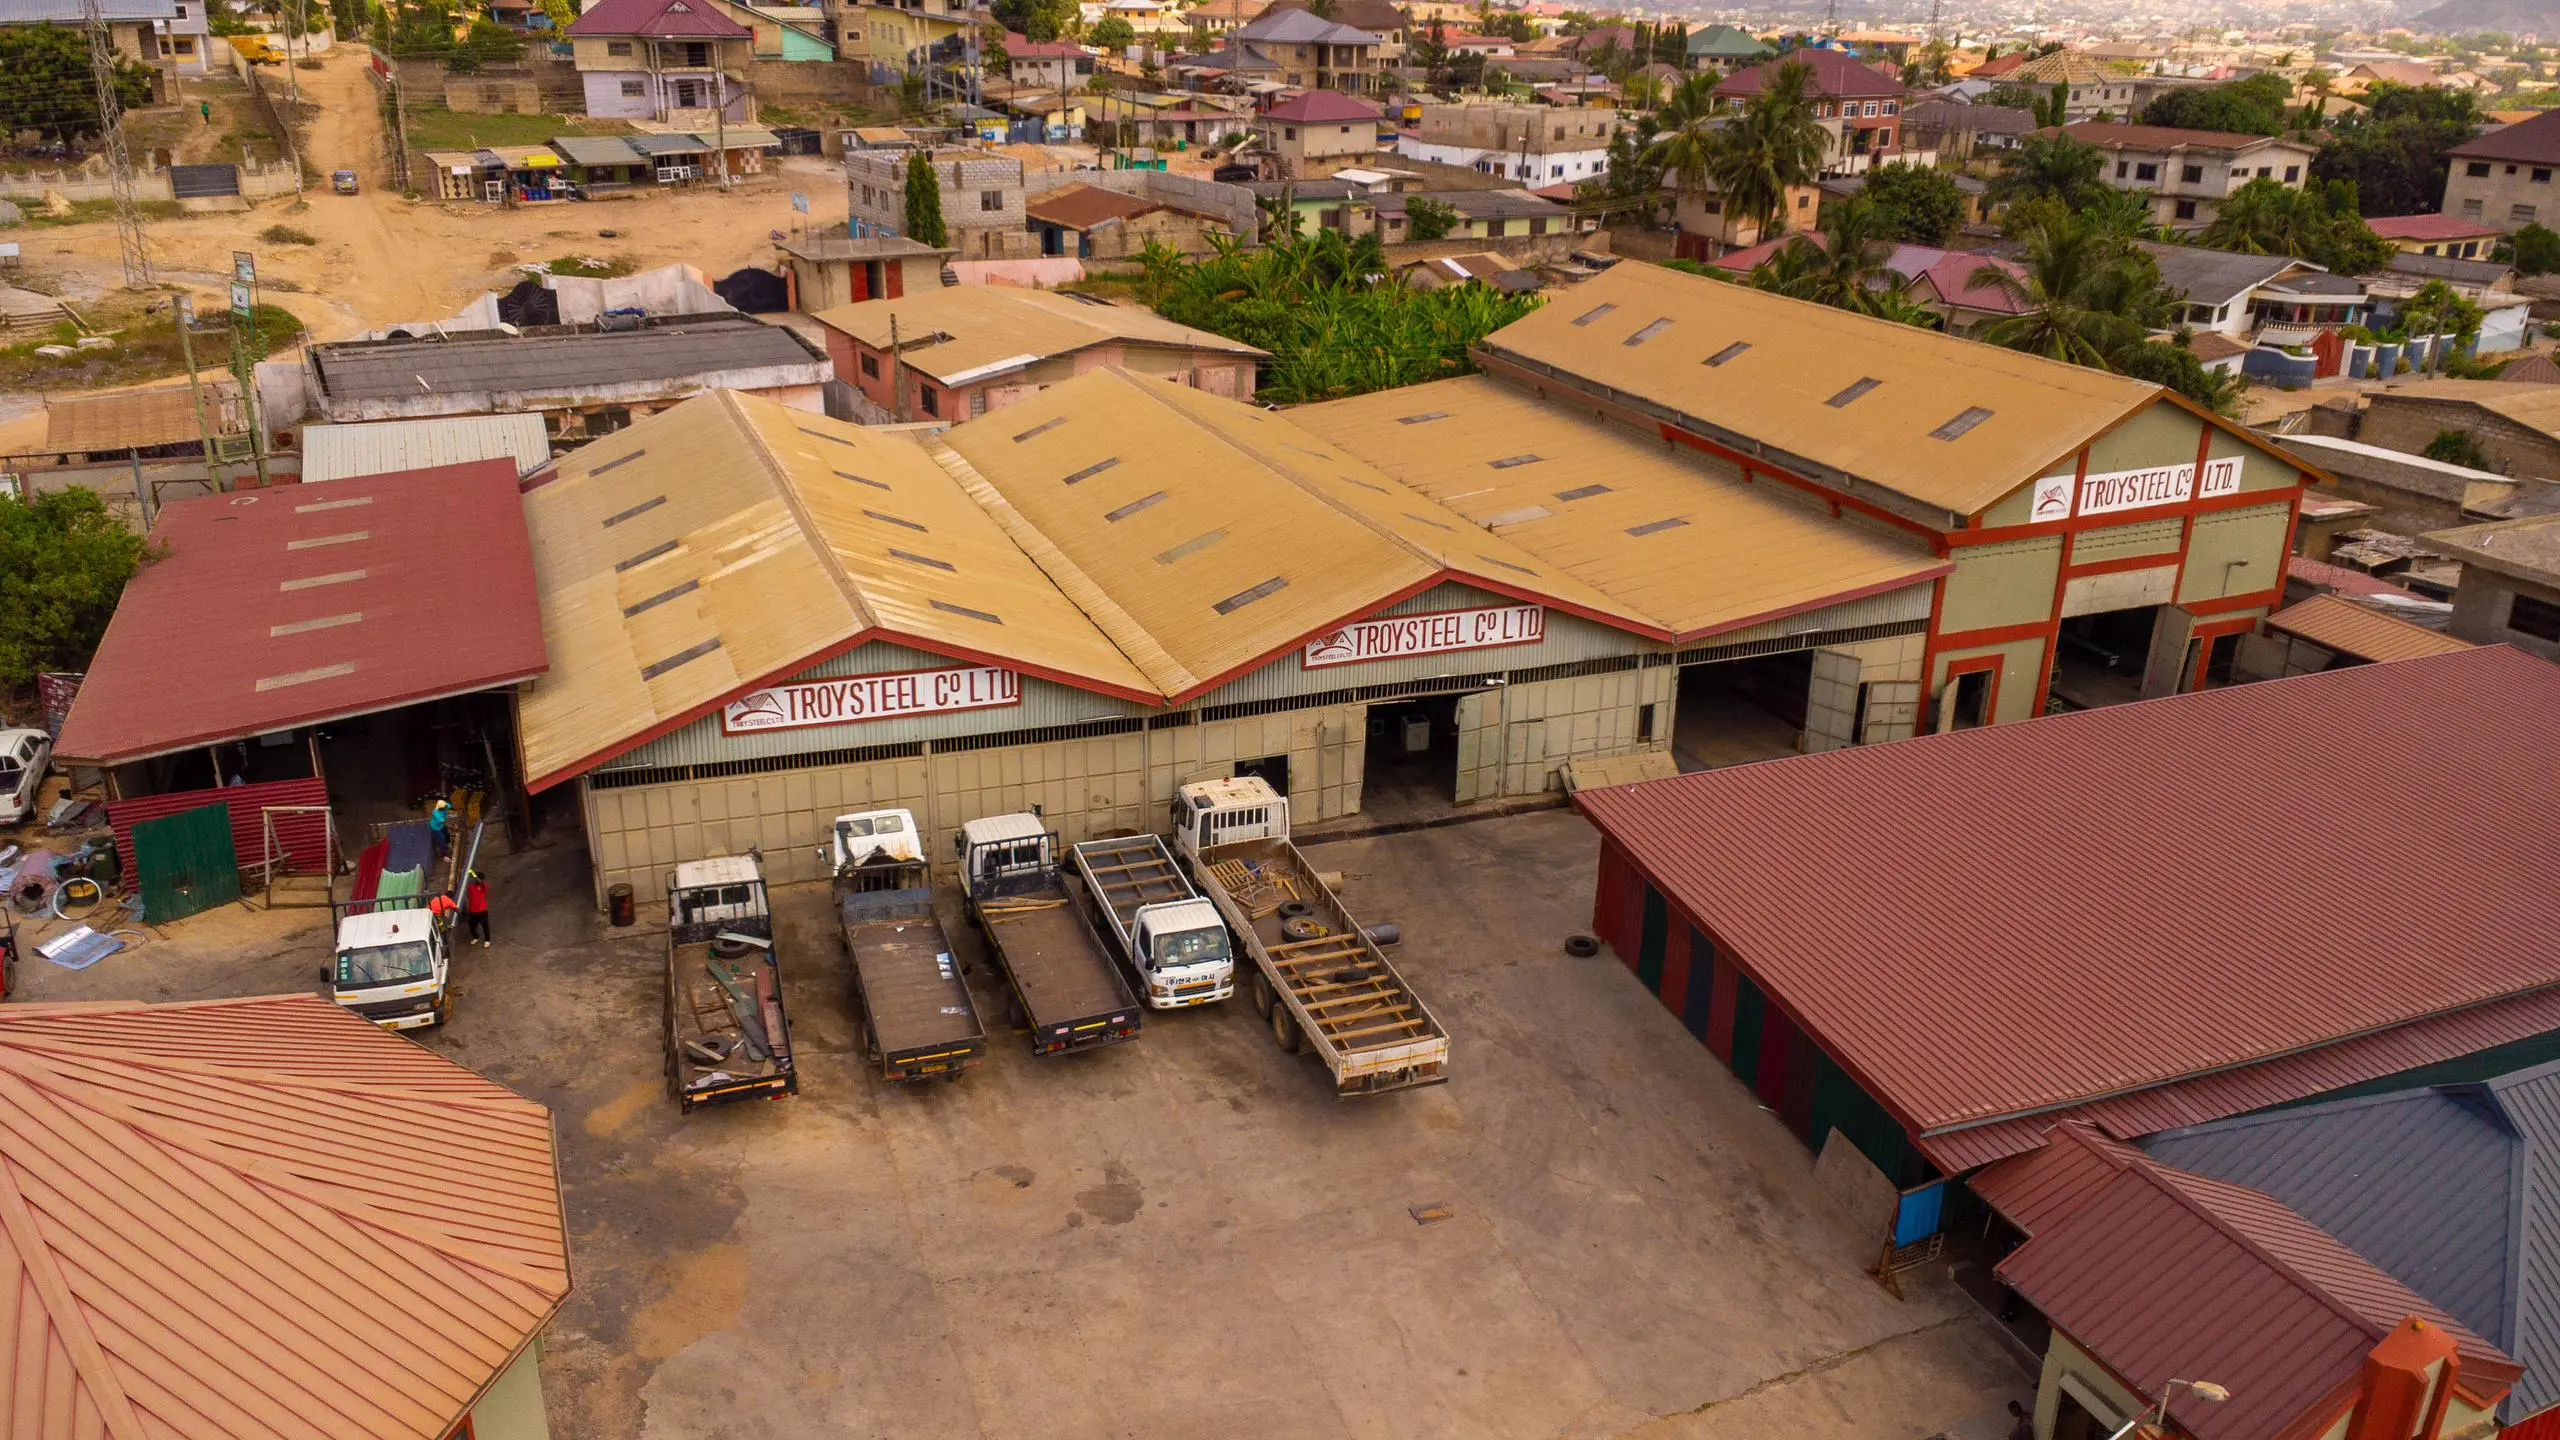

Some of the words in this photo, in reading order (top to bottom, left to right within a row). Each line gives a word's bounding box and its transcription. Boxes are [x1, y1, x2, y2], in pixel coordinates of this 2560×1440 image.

[2084, 471, 2171, 509] TROYSTEEL
[2204, 463, 2233, 491] LTD.
[1354, 616, 1466, 656] TROYSTEEL
[784, 676, 925, 720] TROYSTEEL
